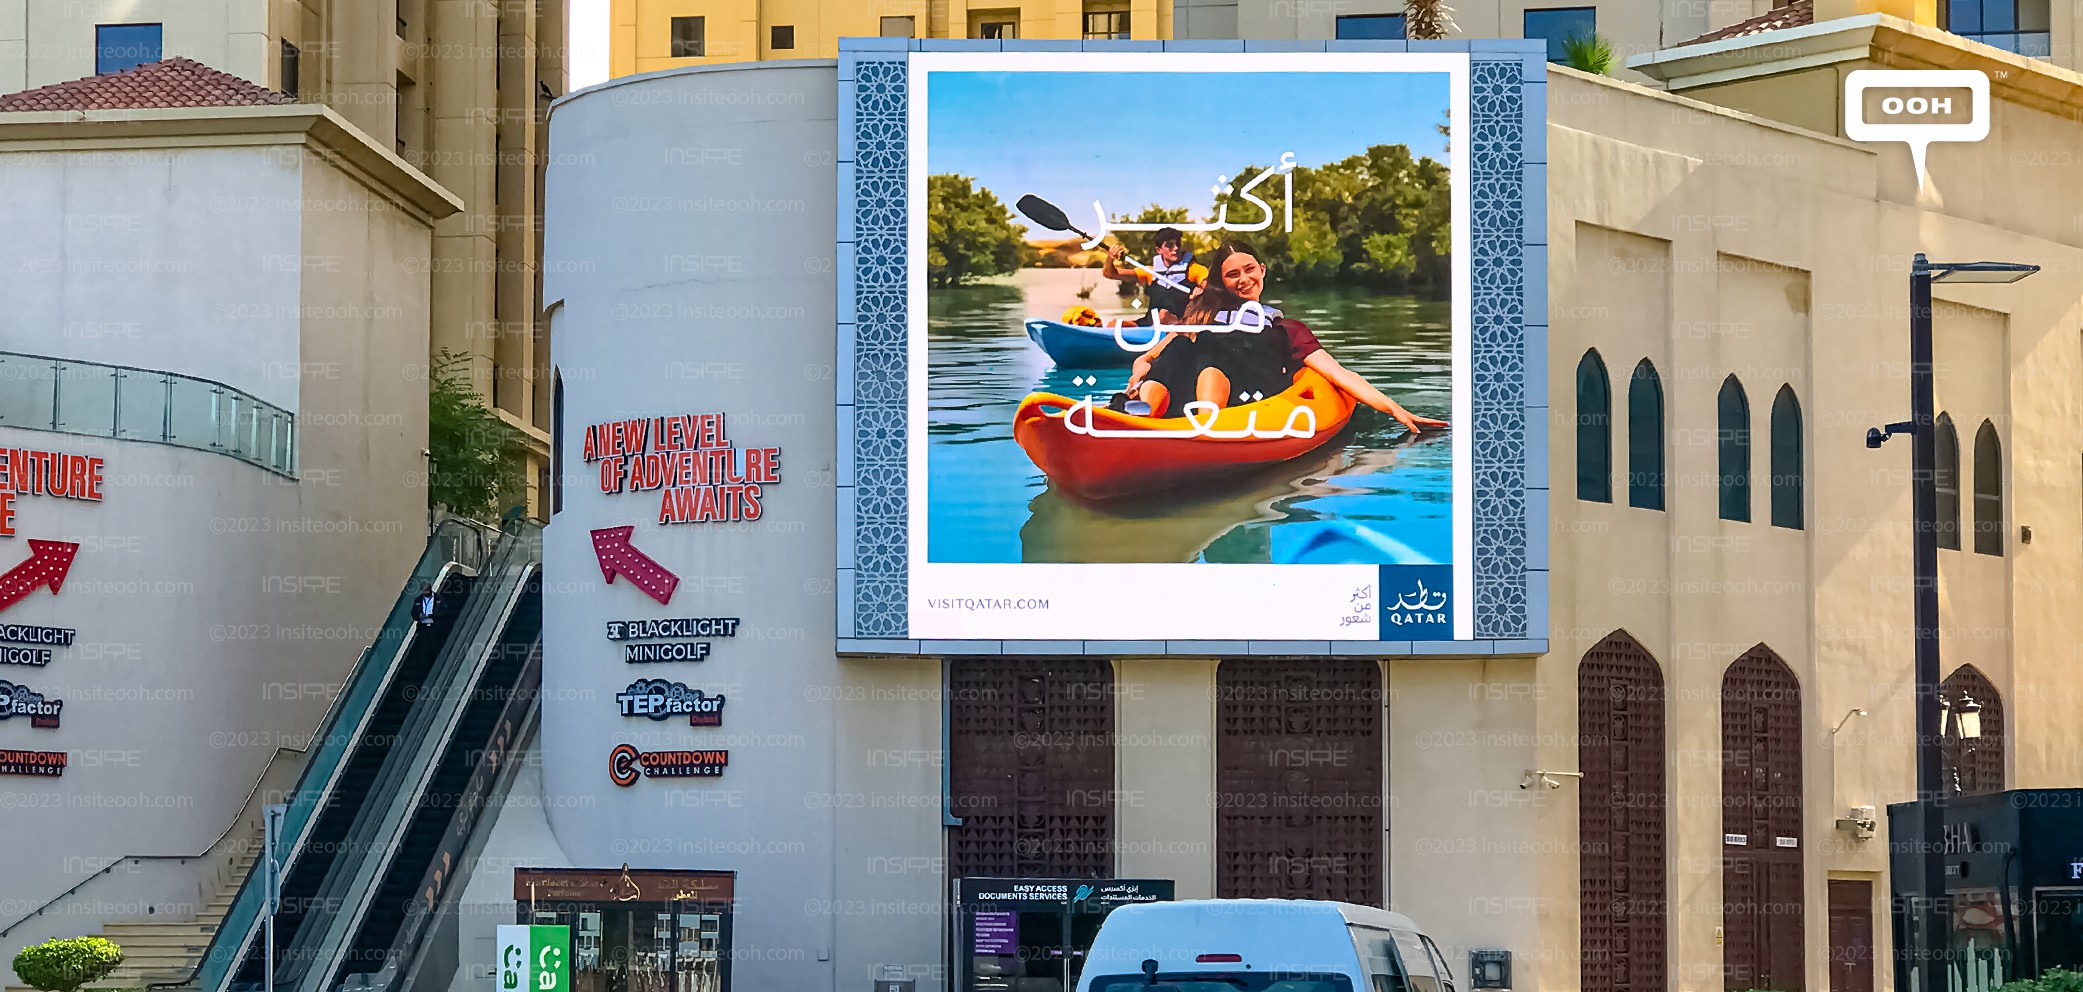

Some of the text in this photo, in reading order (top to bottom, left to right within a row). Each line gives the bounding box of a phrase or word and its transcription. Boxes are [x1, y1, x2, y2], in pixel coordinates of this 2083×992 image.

[1081, 152, 1297, 250] أكثر
[1114, 298, 1265, 351] من
[1064, 374, 1316, 438] متعة
[598, 418, 647, 459] NEW
[653, 413, 731, 452] LEVEL
[600, 447, 780, 494] OF ADVENTURE
[659, 484, 762, 525] AWAITS
[1350, 584, 1372, 603] أكثر
[927, 597, 1050, 611] VISITQATAR.COM
[1354, 601, 1372, 613] من
[628, 619, 737, 638] BLACKLIGHT
[1339, 612, 1372, 627] شعور
[1390, 612, 1447, 626] QATAR
[625, 643, 708, 662] MINIGOLF
[640, 751, 727, 766] COUNTDOWN
[645, 766, 720, 776] CHALLENGE
[978, 892, 1068, 900] DOCUMENTS SERVICES
[1013, 884, 1068, 893] EASY ACCESS
